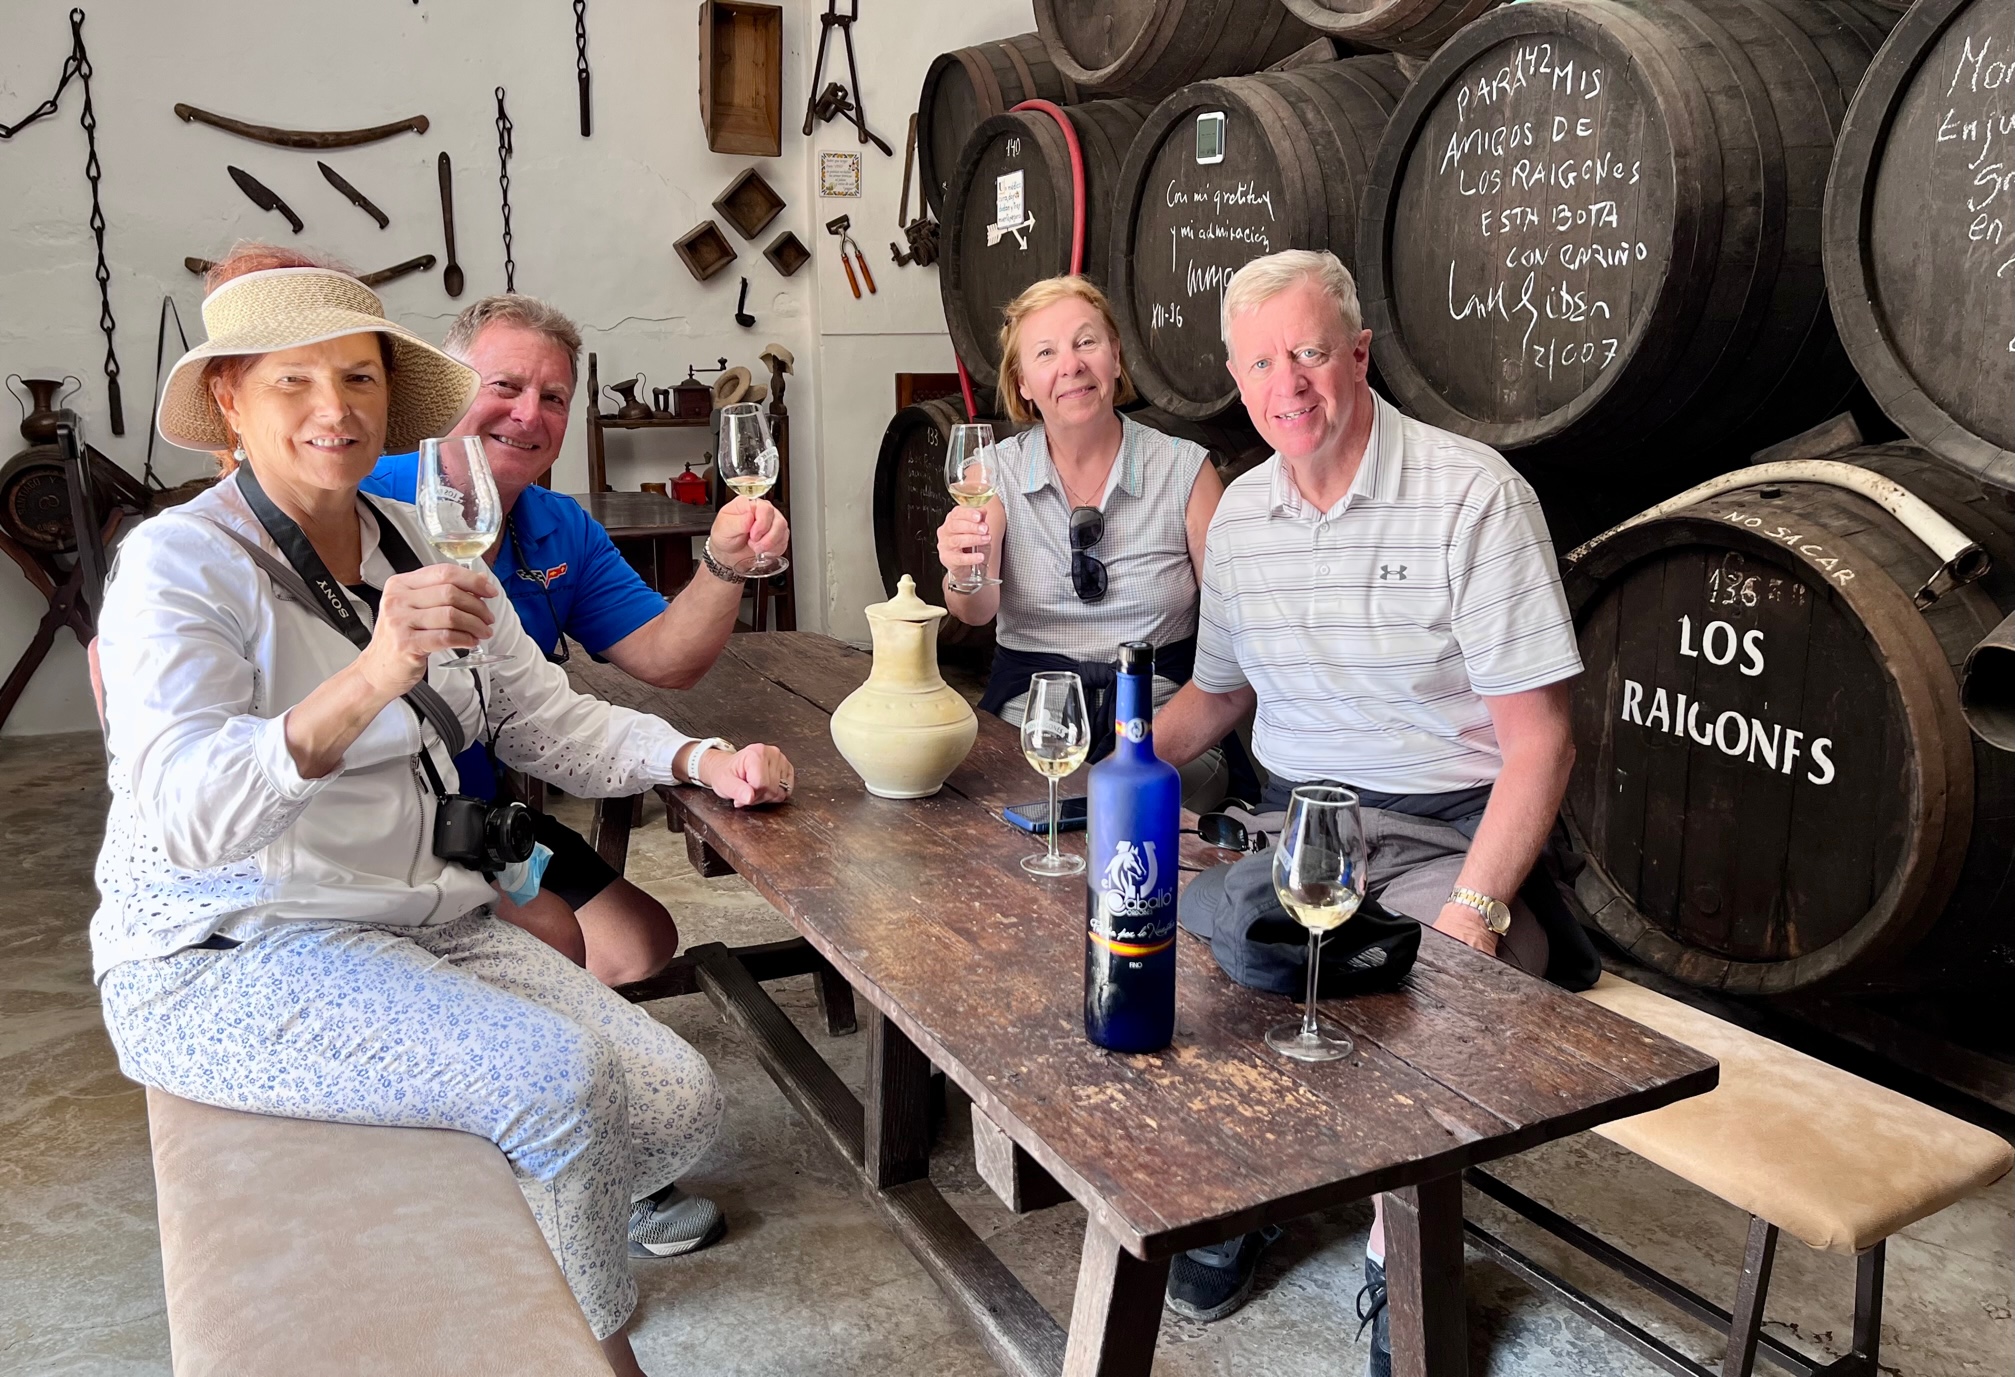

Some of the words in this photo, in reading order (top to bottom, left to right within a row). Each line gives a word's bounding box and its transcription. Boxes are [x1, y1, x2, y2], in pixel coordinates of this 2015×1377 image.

[1515, 44, 1551, 75] 142
[1457, 66, 1527, 122] PARA
[1552, 60, 1601, 100] MIS
[1006, 137, 1021, 158] 140
[1440, 122, 1533, 175] AMIGOS
[1552, 115, 1593, 143] DE
[1166, 180, 1188, 208] Con
[1459, 169, 1502, 196] LOS
[1481, 207, 1540, 237] ESTA
[1552, 201, 1618, 232] BOTA
[1968, 213, 2003, 245] en
[1170, 225, 1176, 273] y
[1180, 219, 1195, 240] mi
[1506, 243, 1553, 268] CON
[927, 426, 939, 447] 133
[1723, 511, 1762, 528] NO
[1764, 526, 1856, 587] SACAR
[315, 580, 350, 619] SONY
[1677, 613, 1766, 677] LOS
[1101, 873, 1112, 889] el
[1105, 887, 1172, 917] Caballo
